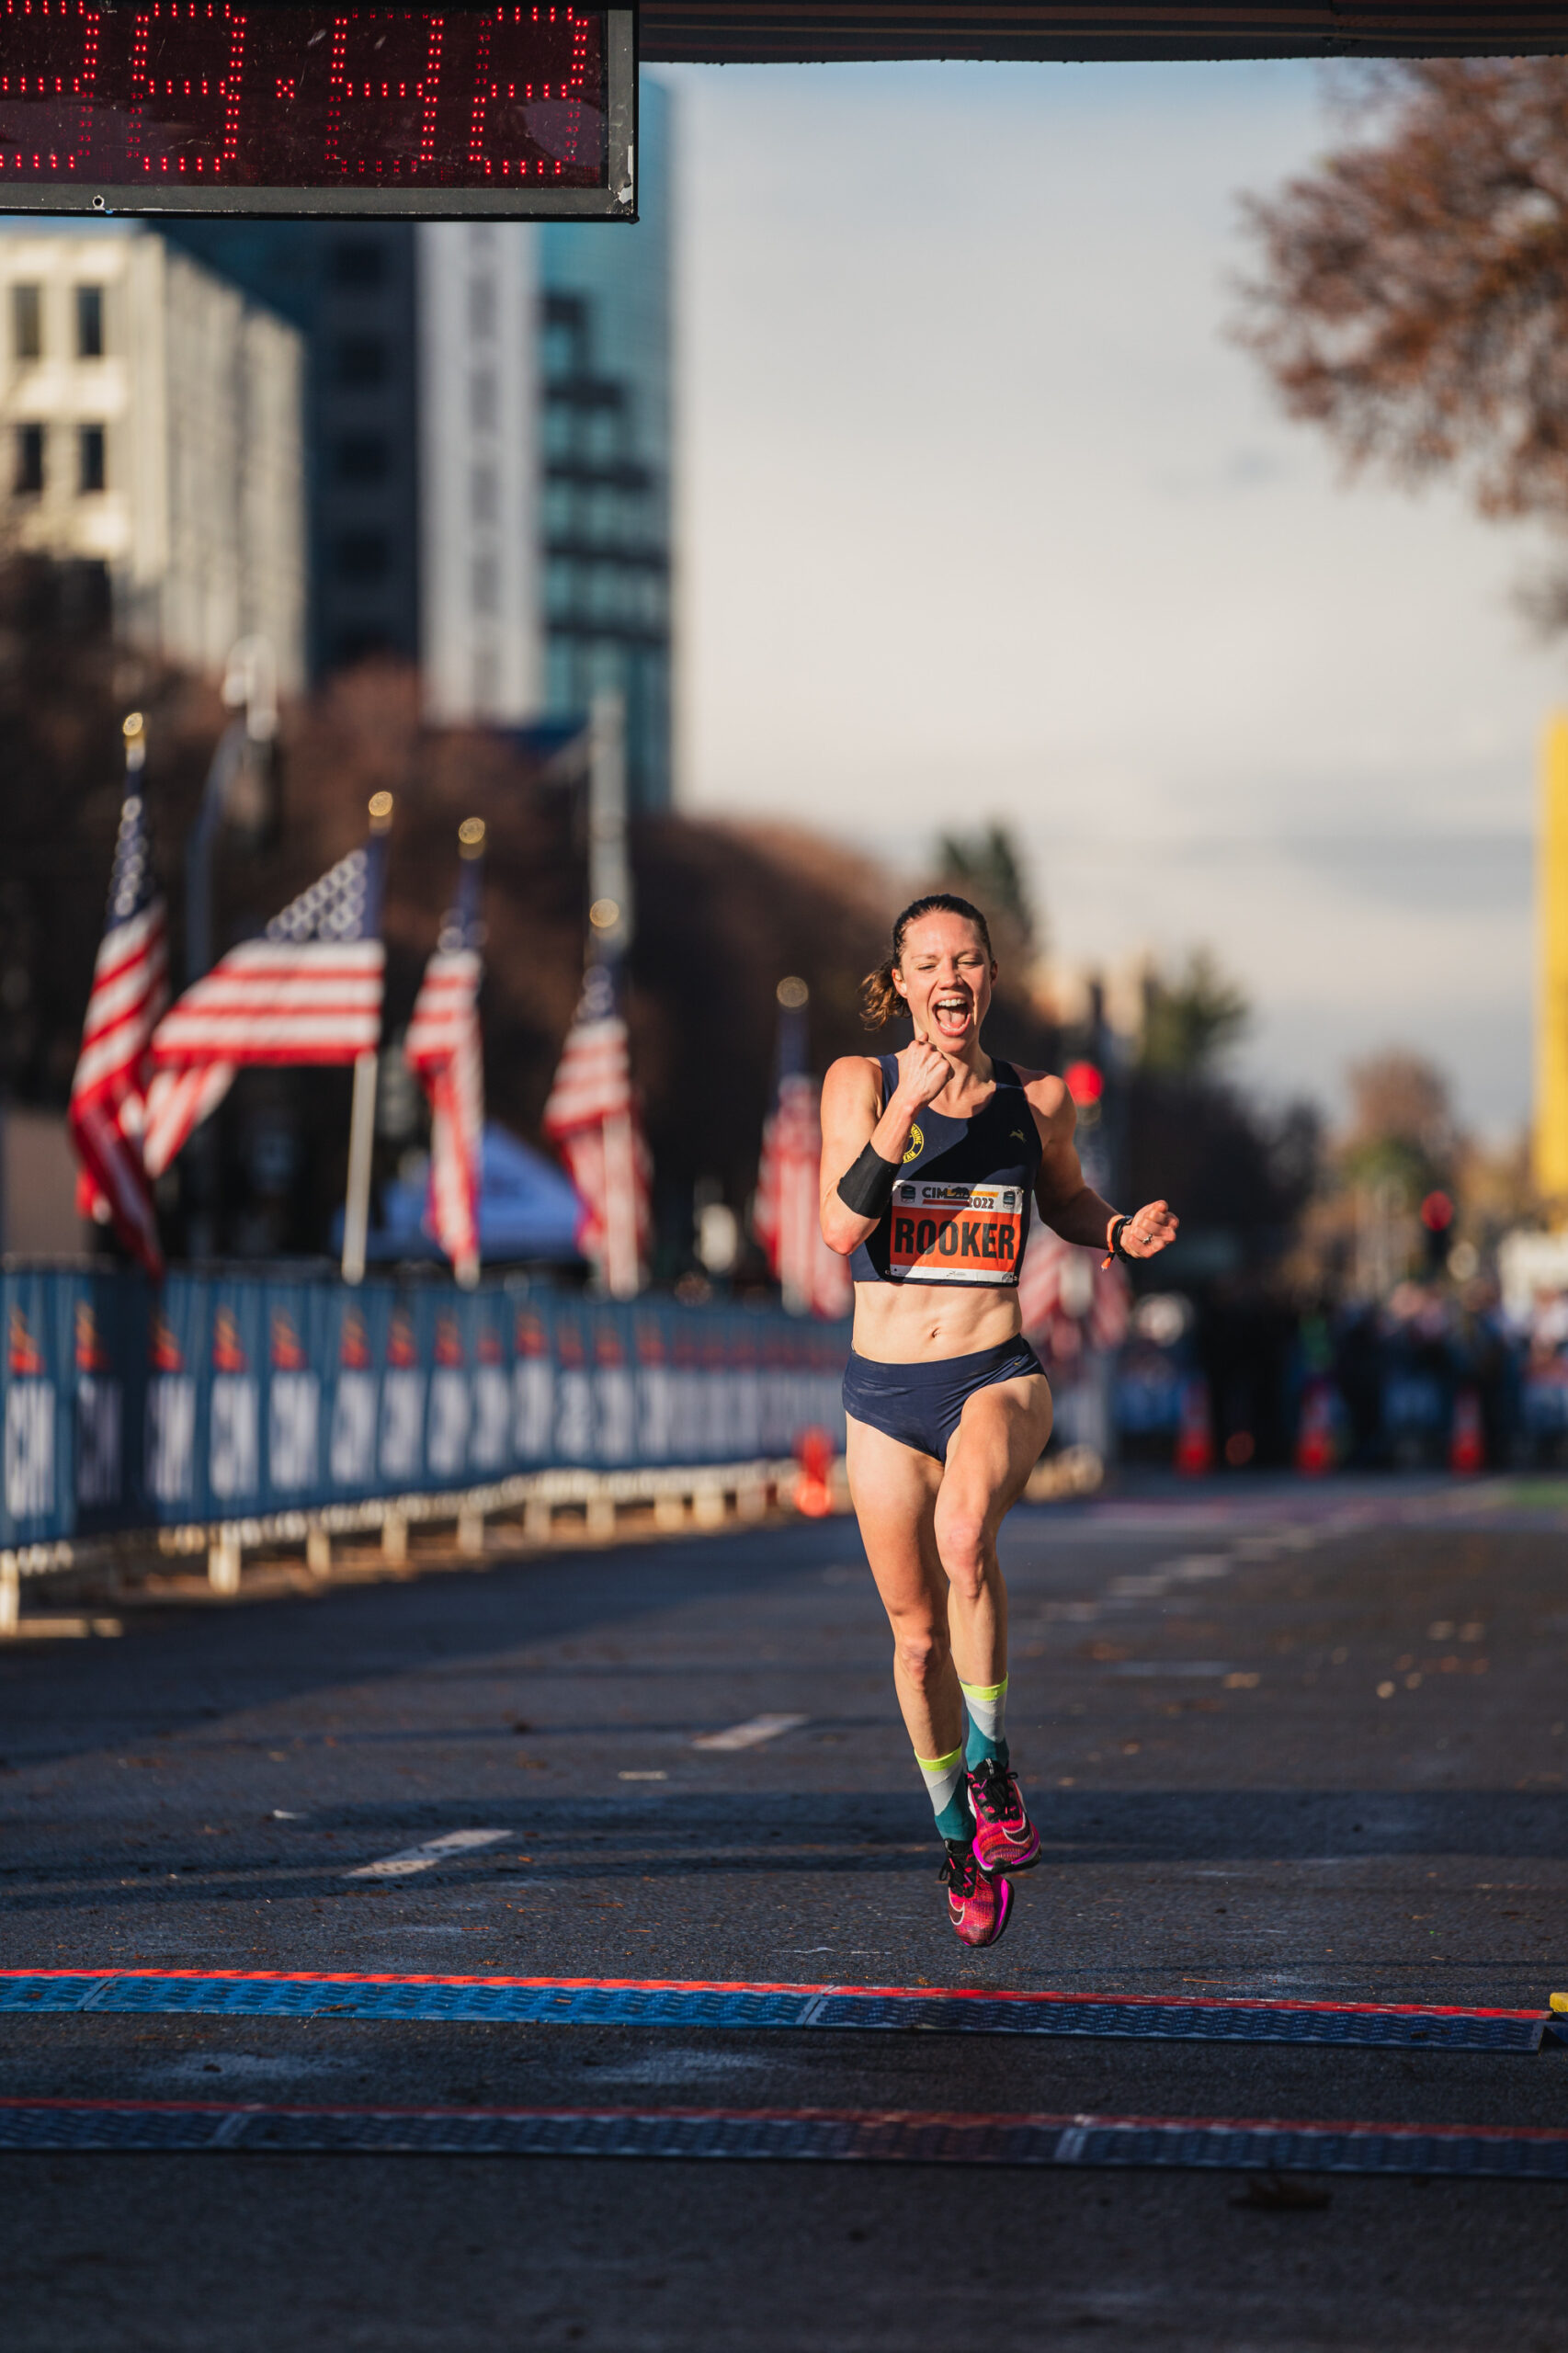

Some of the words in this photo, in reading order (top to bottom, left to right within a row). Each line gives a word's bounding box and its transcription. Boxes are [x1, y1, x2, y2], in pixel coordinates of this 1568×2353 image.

[922, 1186, 948, 1199] CIM
[968, 1197, 994, 1210] 2022
[894, 1217, 1015, 1260] ROOKER
